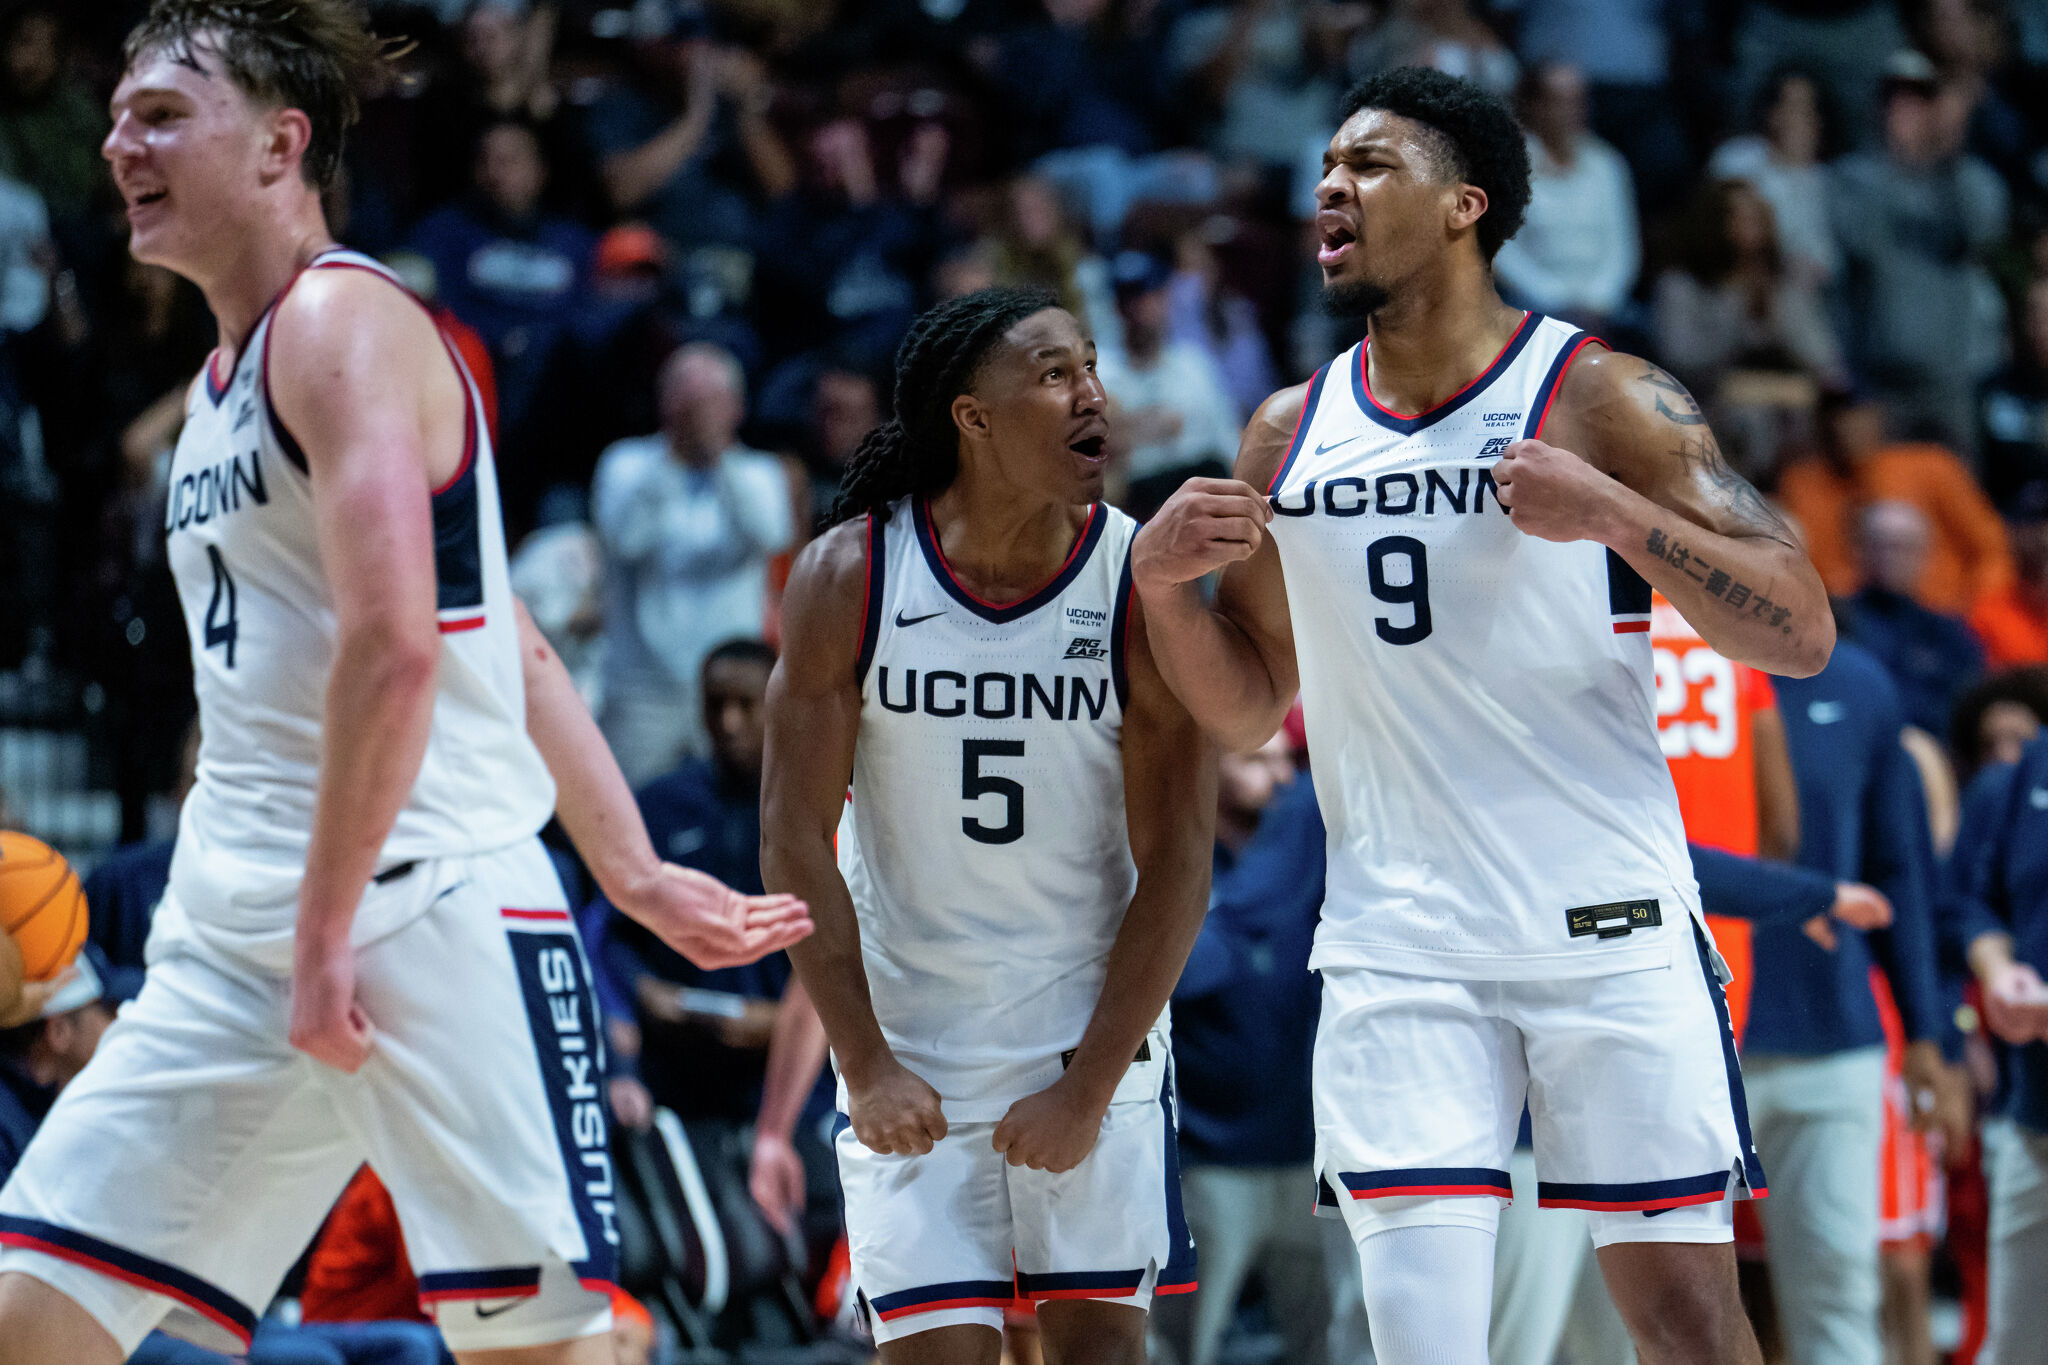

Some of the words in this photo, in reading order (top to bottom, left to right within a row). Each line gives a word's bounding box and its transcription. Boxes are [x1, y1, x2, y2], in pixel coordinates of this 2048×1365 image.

[1483, 413, 1521, 421] UCONN
[1485, 437, 1513, 446] BIG
[1479, 446, 1508, 455] EAS
[1366, 535, 1433, 646] 9
[205, 543, 238, 669] 4
[1066, 607, 1106, 621] UCONN
[1069, 618, 1101, 627] HEALTH
[1070, 637, 1102, 648] BIG
[1064, 646, 1109, 658] EAST
[878, 665, 1109, 721] UCONN
[1653, 647, 1738, 759] 23
[961, 739, 1025, 845] 5
[1632, 908, 1647, 919] 50
